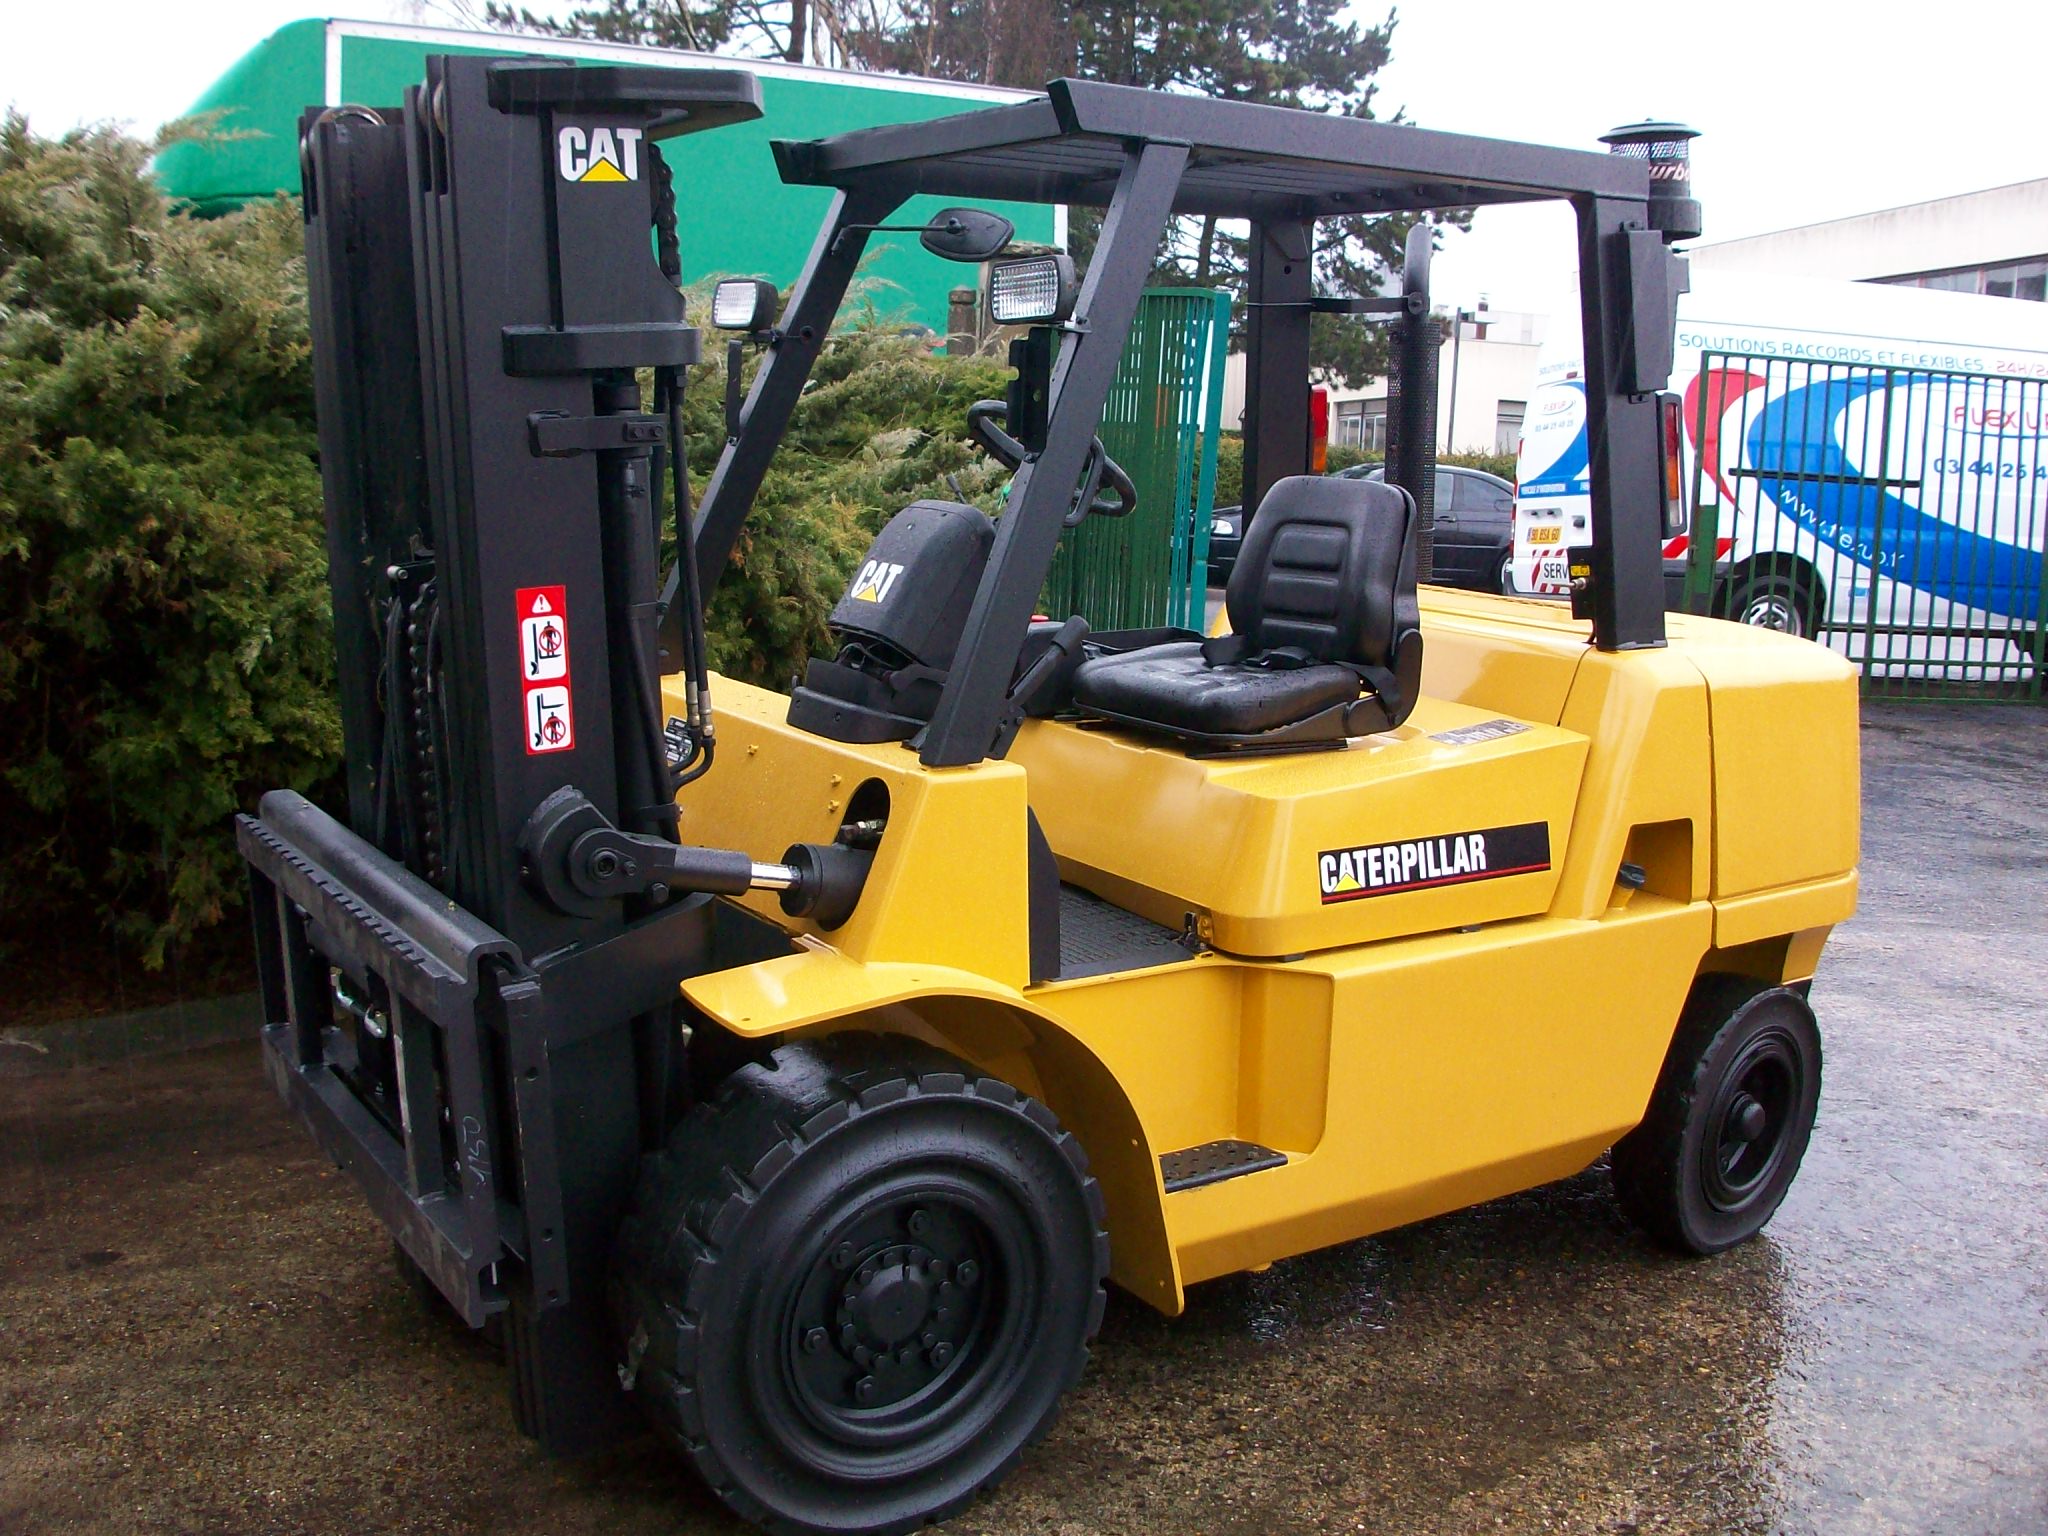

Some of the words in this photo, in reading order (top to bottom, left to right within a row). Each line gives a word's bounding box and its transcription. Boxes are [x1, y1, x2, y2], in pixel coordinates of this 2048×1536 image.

[558, 126, 642, 182] CAT
[1679, 333, 1777, 355] SOLUTIONS
[1782, 342, 1872, 363] RACCORDS
[1877, 351, 1895, 364] ET
[1901, 353, 1984, 372] FLEXIBLES
[850, 560, 905, 604] CAT
[1319, 833, 1487, 894] CATERPILLAR
